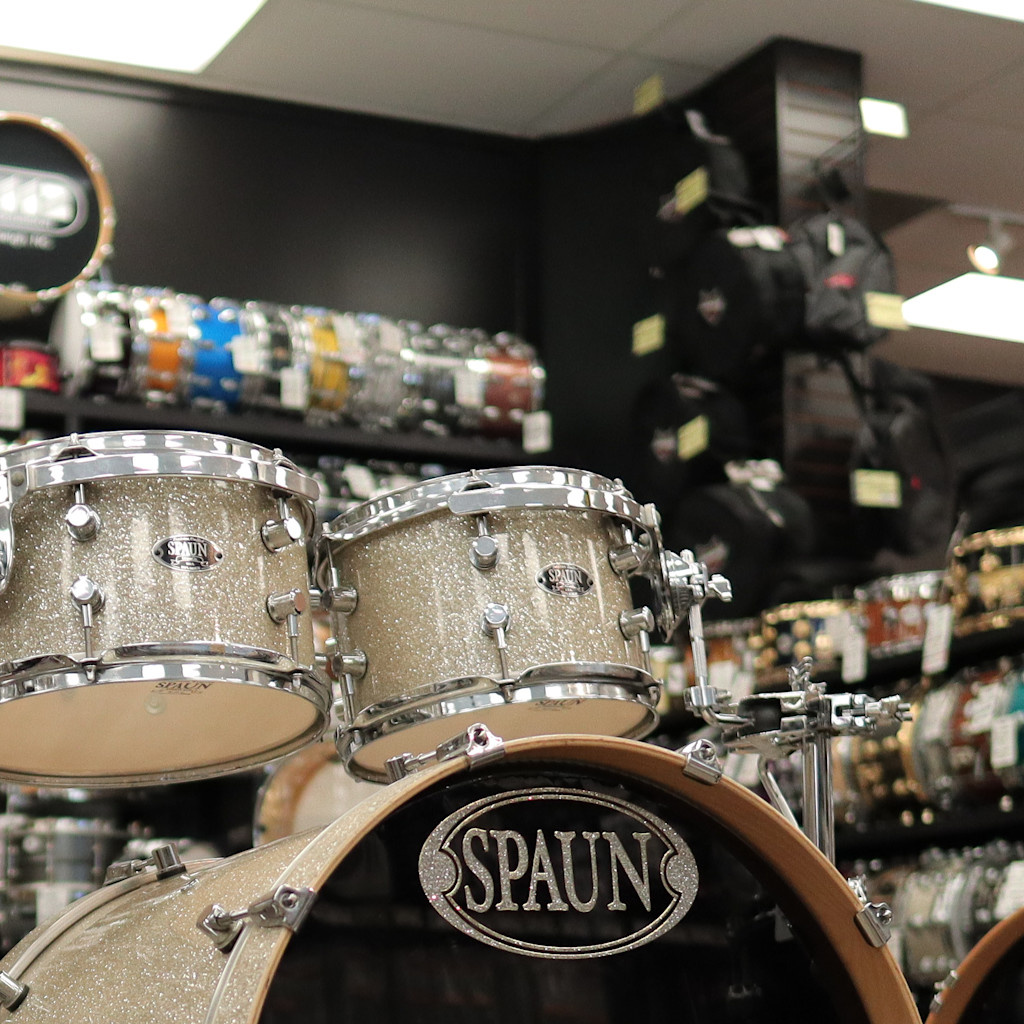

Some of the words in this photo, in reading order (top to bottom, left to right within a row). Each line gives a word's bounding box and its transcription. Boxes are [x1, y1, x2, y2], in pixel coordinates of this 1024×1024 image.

[167, 541, 209, 557] SPAUN
[548, 568, 583, 584] SPAUN
[155, 680, 213, 691] SPAUN
[462, 828, 652, 914] SPAUN
